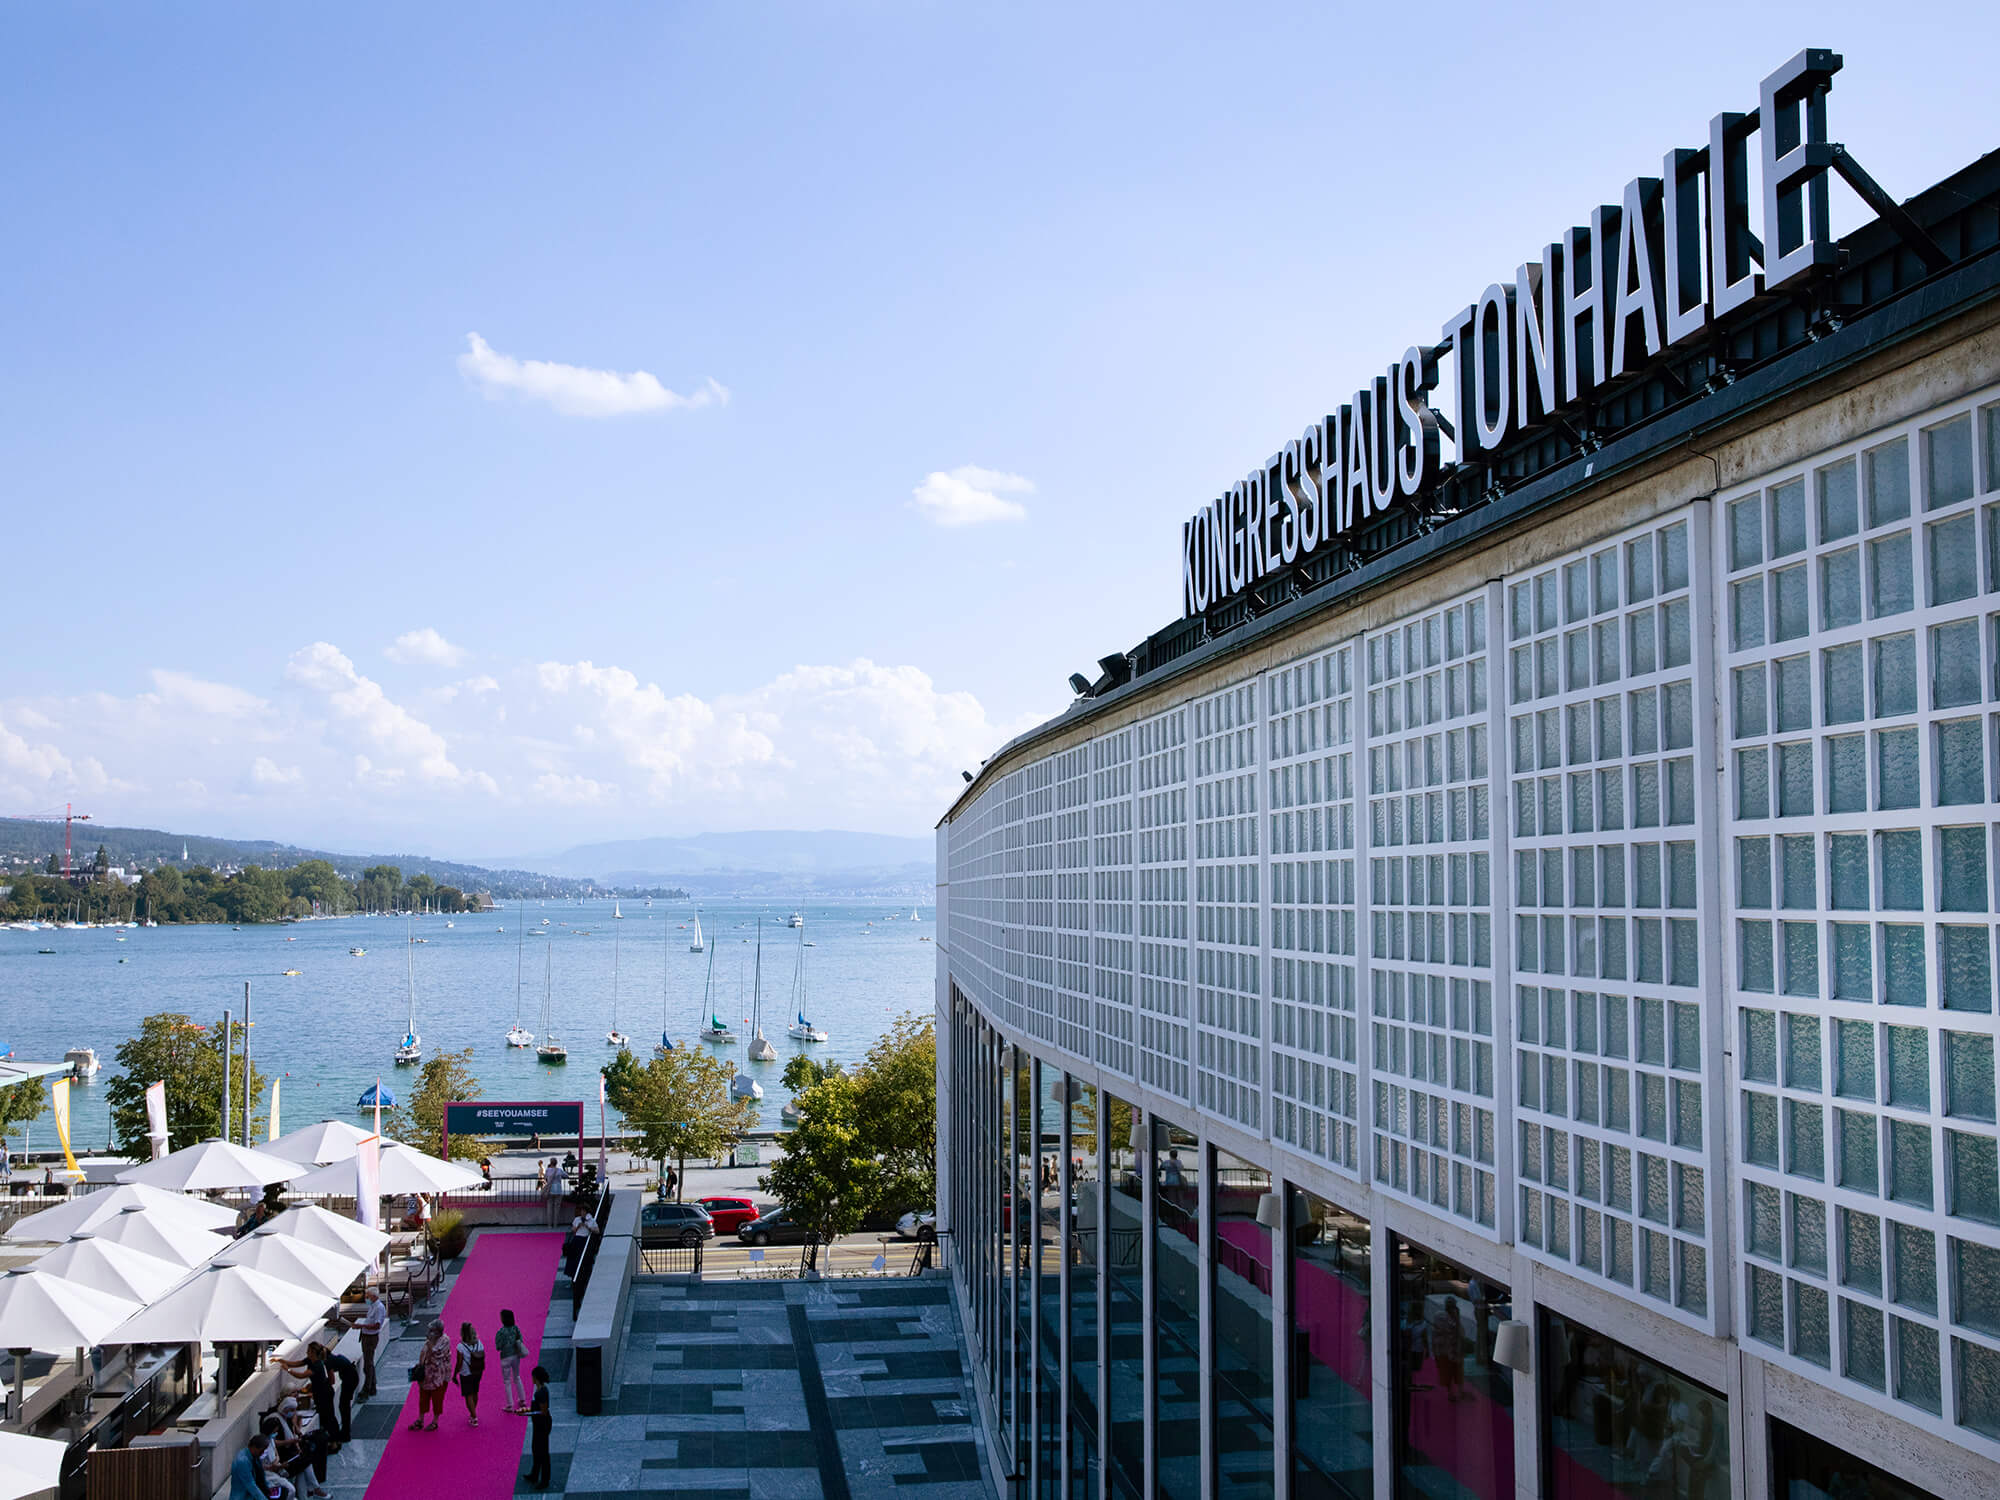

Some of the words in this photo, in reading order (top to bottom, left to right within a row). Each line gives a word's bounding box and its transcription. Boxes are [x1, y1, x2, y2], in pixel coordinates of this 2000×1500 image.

[1182, 345, 1432, 619] KONGRESSHAUS
[1442, 48, 1819, 466] TONHALLE
[476, 1109, 549, 1118] #SEEYOUAMSEE
